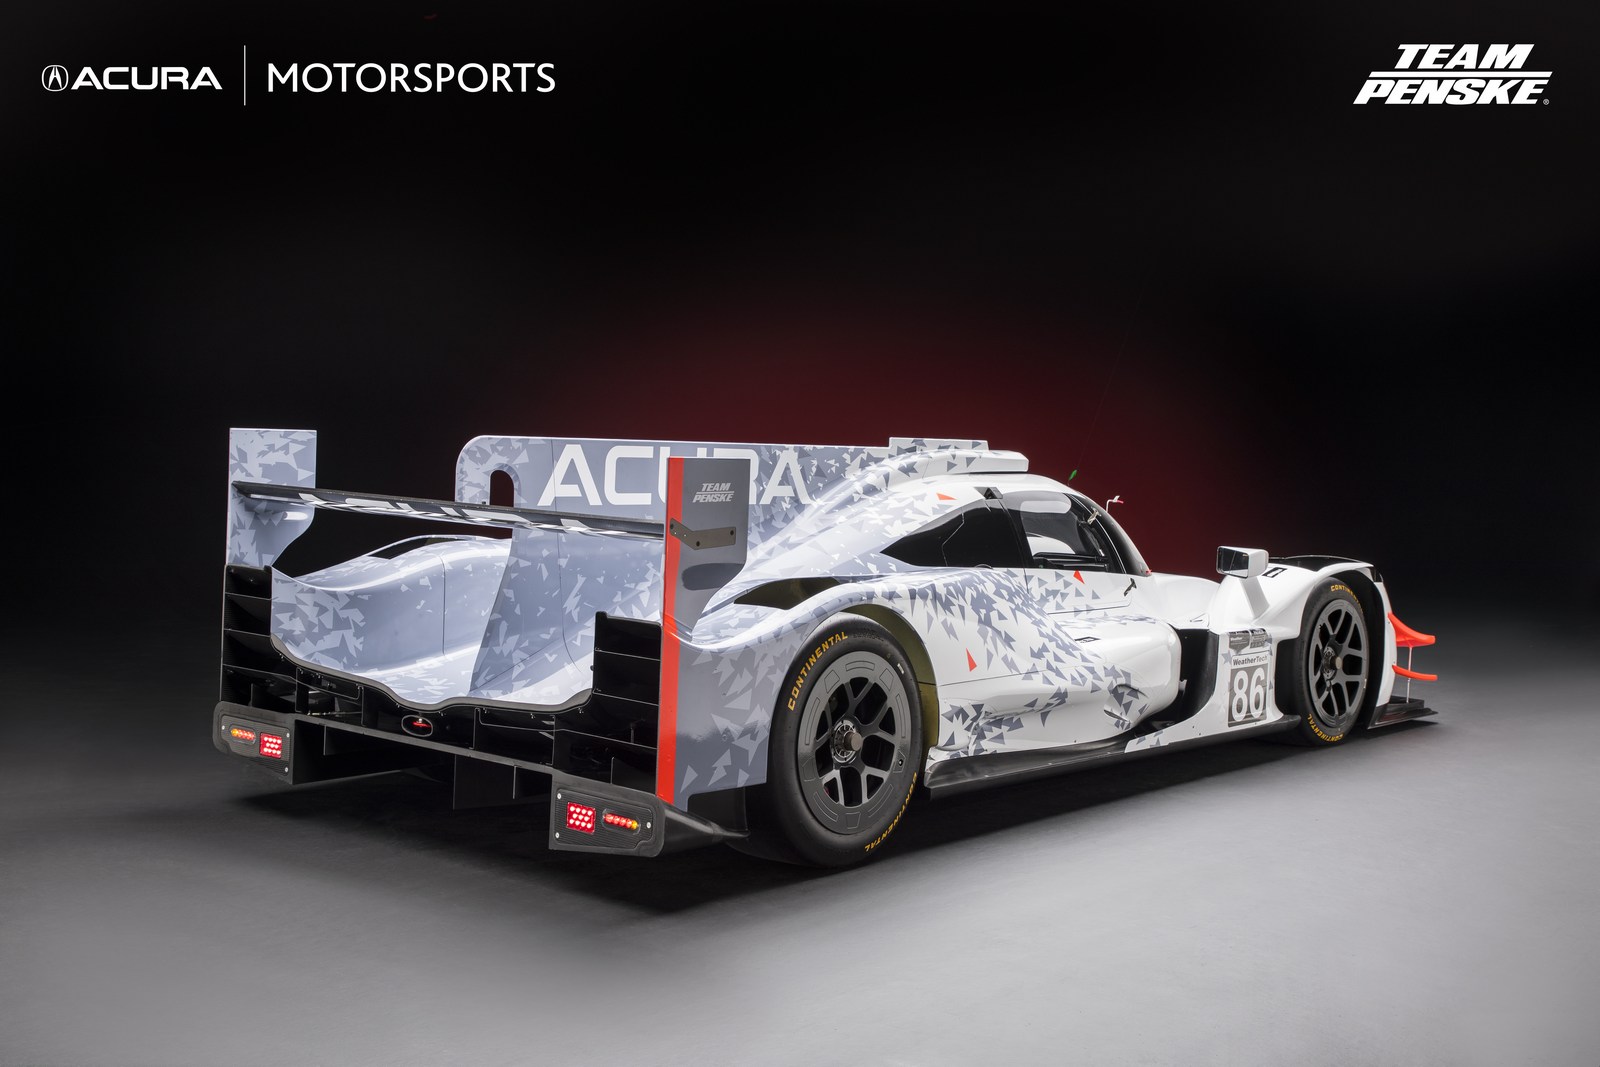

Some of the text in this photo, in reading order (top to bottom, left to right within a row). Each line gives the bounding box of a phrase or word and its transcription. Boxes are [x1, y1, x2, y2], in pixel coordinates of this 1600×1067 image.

[537, 443, 818, 507] ACA
[701, 482, 731, 492] TEAM
[692, 493, 734, 503] PENSKE
[787, 631, 849, 712] CONTINENTAL
[1232, 655, 1268, 666] WeatherTech
[1231, 667, 1265, 722] 86
